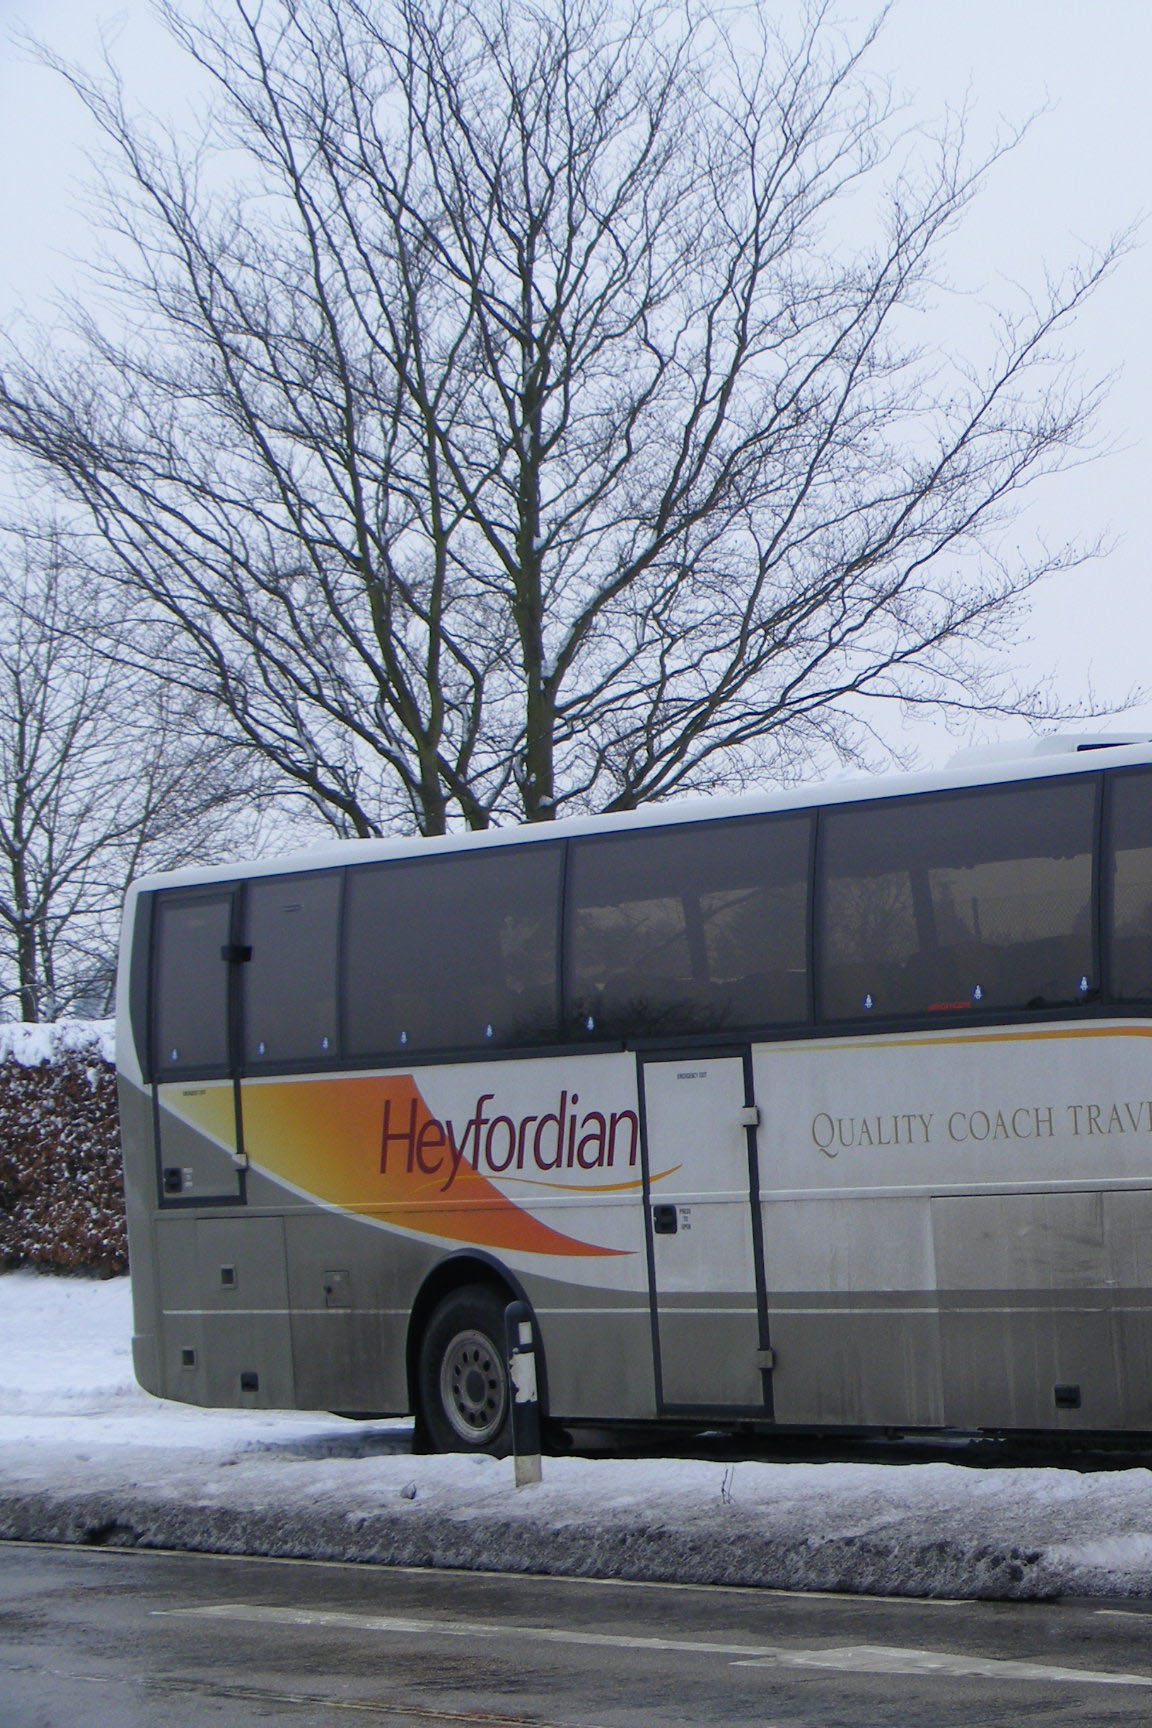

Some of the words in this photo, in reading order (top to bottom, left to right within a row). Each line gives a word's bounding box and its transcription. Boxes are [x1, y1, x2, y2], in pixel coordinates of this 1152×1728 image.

[379, 1089, 640, 1193] Heyfordian
[811, 1111, 935, 1159] QUALITY
[948, 1105, 1055, 1143] COACH
